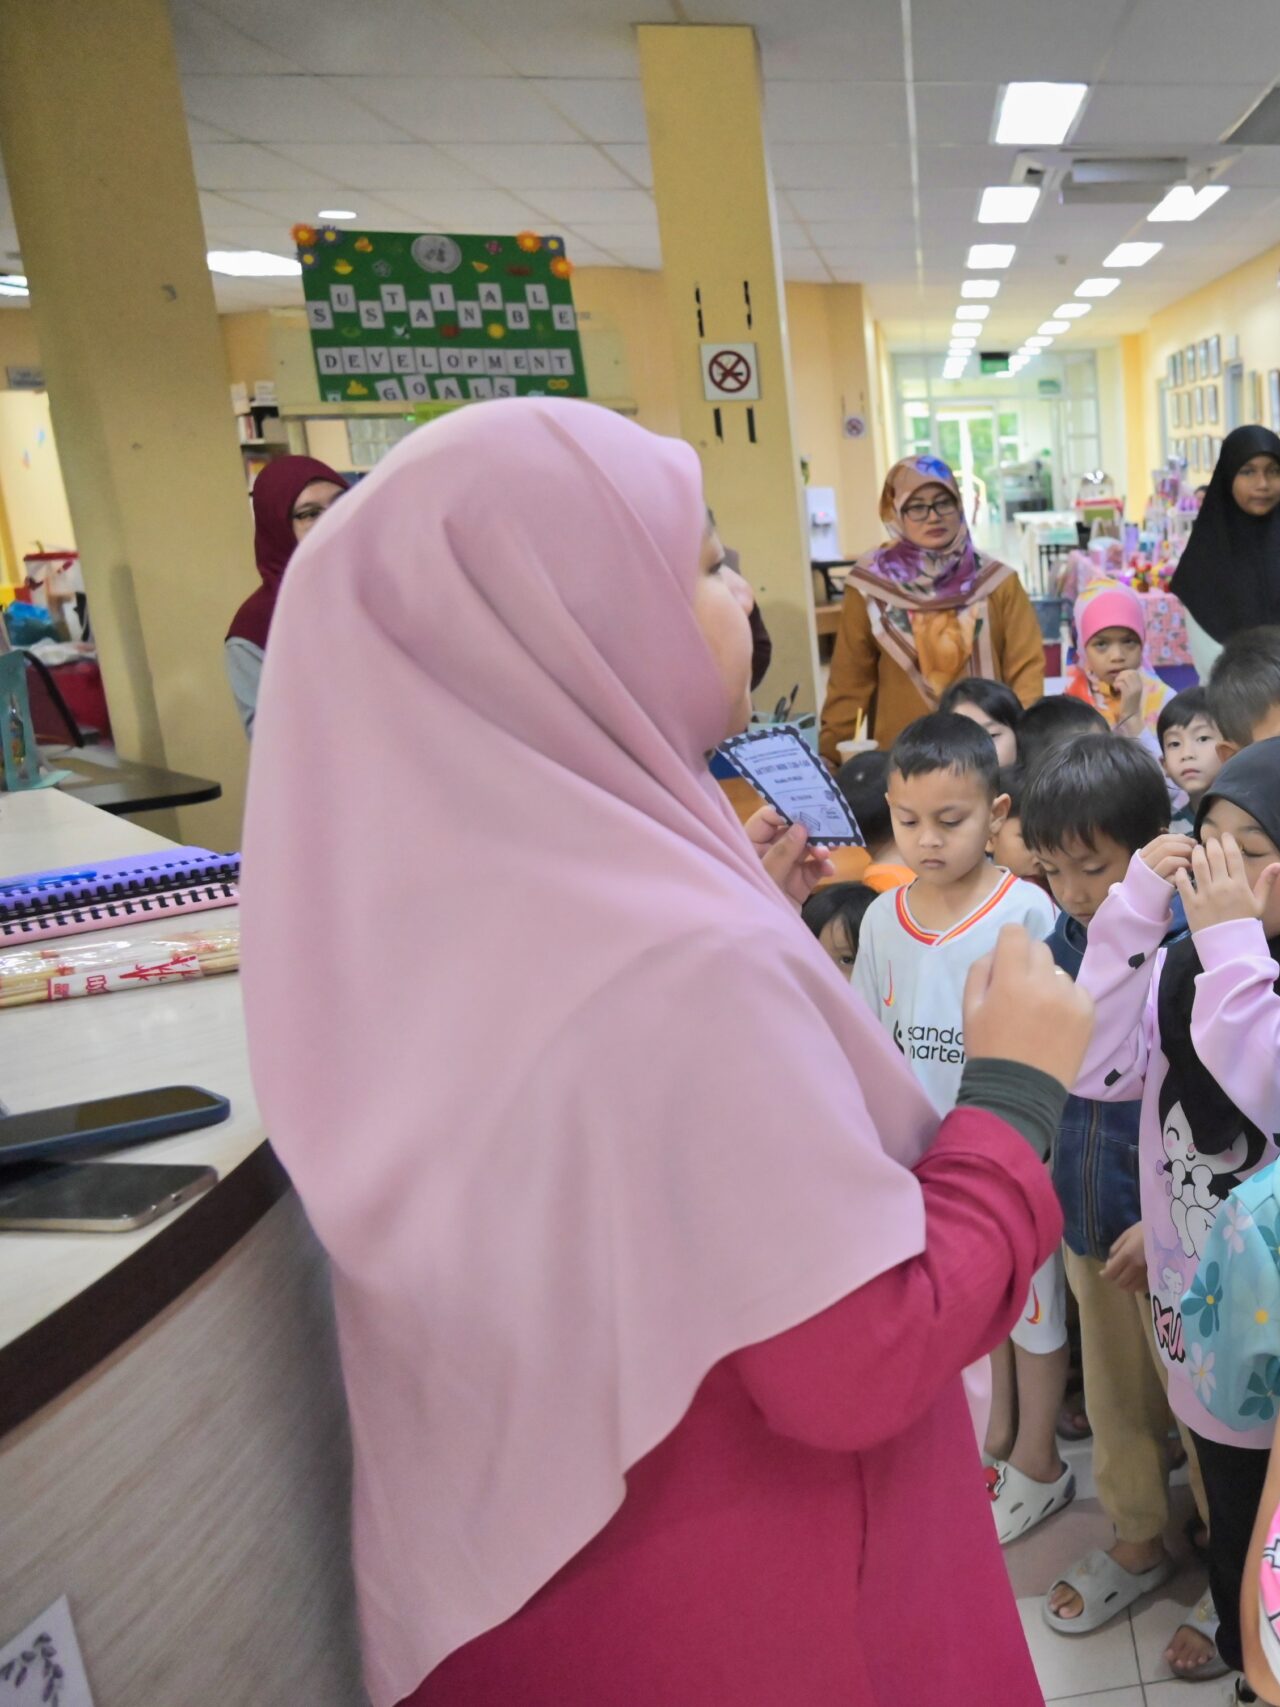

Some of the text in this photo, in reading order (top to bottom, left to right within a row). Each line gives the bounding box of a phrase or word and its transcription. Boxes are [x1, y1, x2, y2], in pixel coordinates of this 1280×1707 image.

[311, 289, 572, 325] SUSTAINABLE
[322, 351, 570, 370] DEVELOPMENT
[381, 380, 513, 401] GOALS
